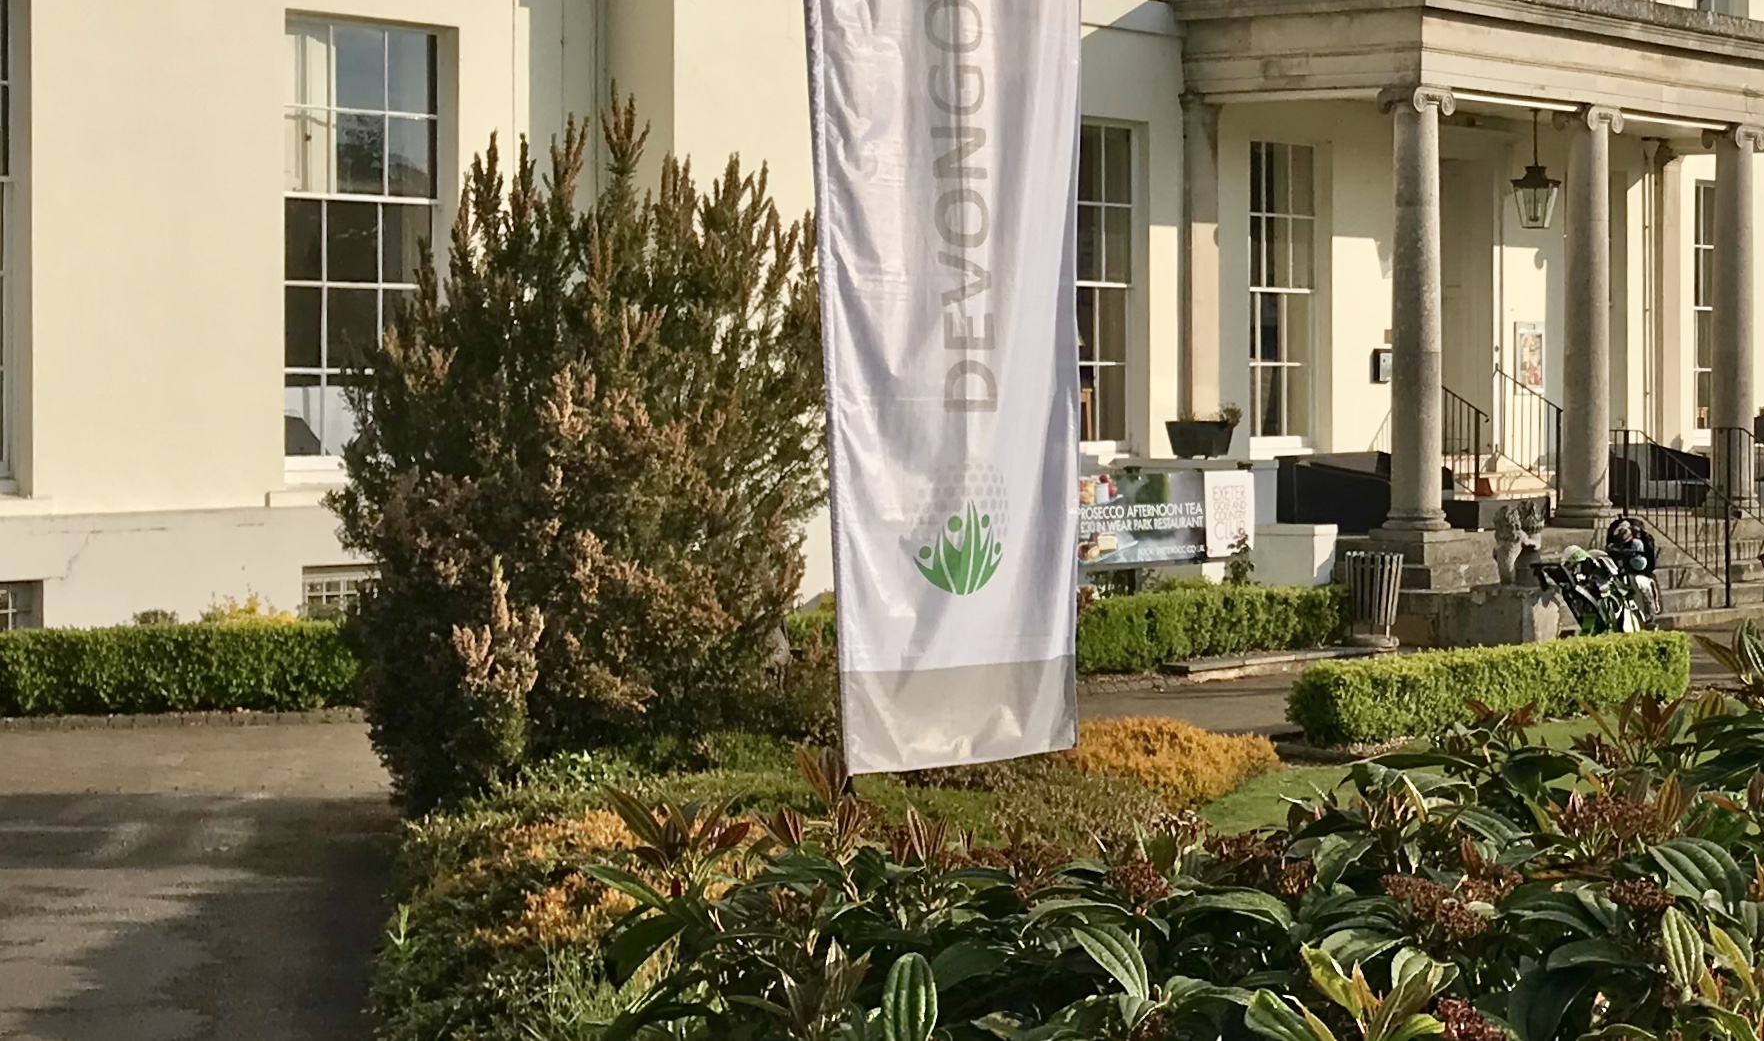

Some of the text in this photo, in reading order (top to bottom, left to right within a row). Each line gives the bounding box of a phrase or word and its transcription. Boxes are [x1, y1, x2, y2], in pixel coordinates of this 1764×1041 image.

[1212, 485, 1247, 501] EXETER
[1126, 502, 1183, 518] AFTERNOON
[1184, 502, 1203, 515] TEA
[1106, 519, 1133, 532] WEAR
[1133, 518, 1154, 531] PARK
[1153, 516, 1204, 530] RESTAURANT
